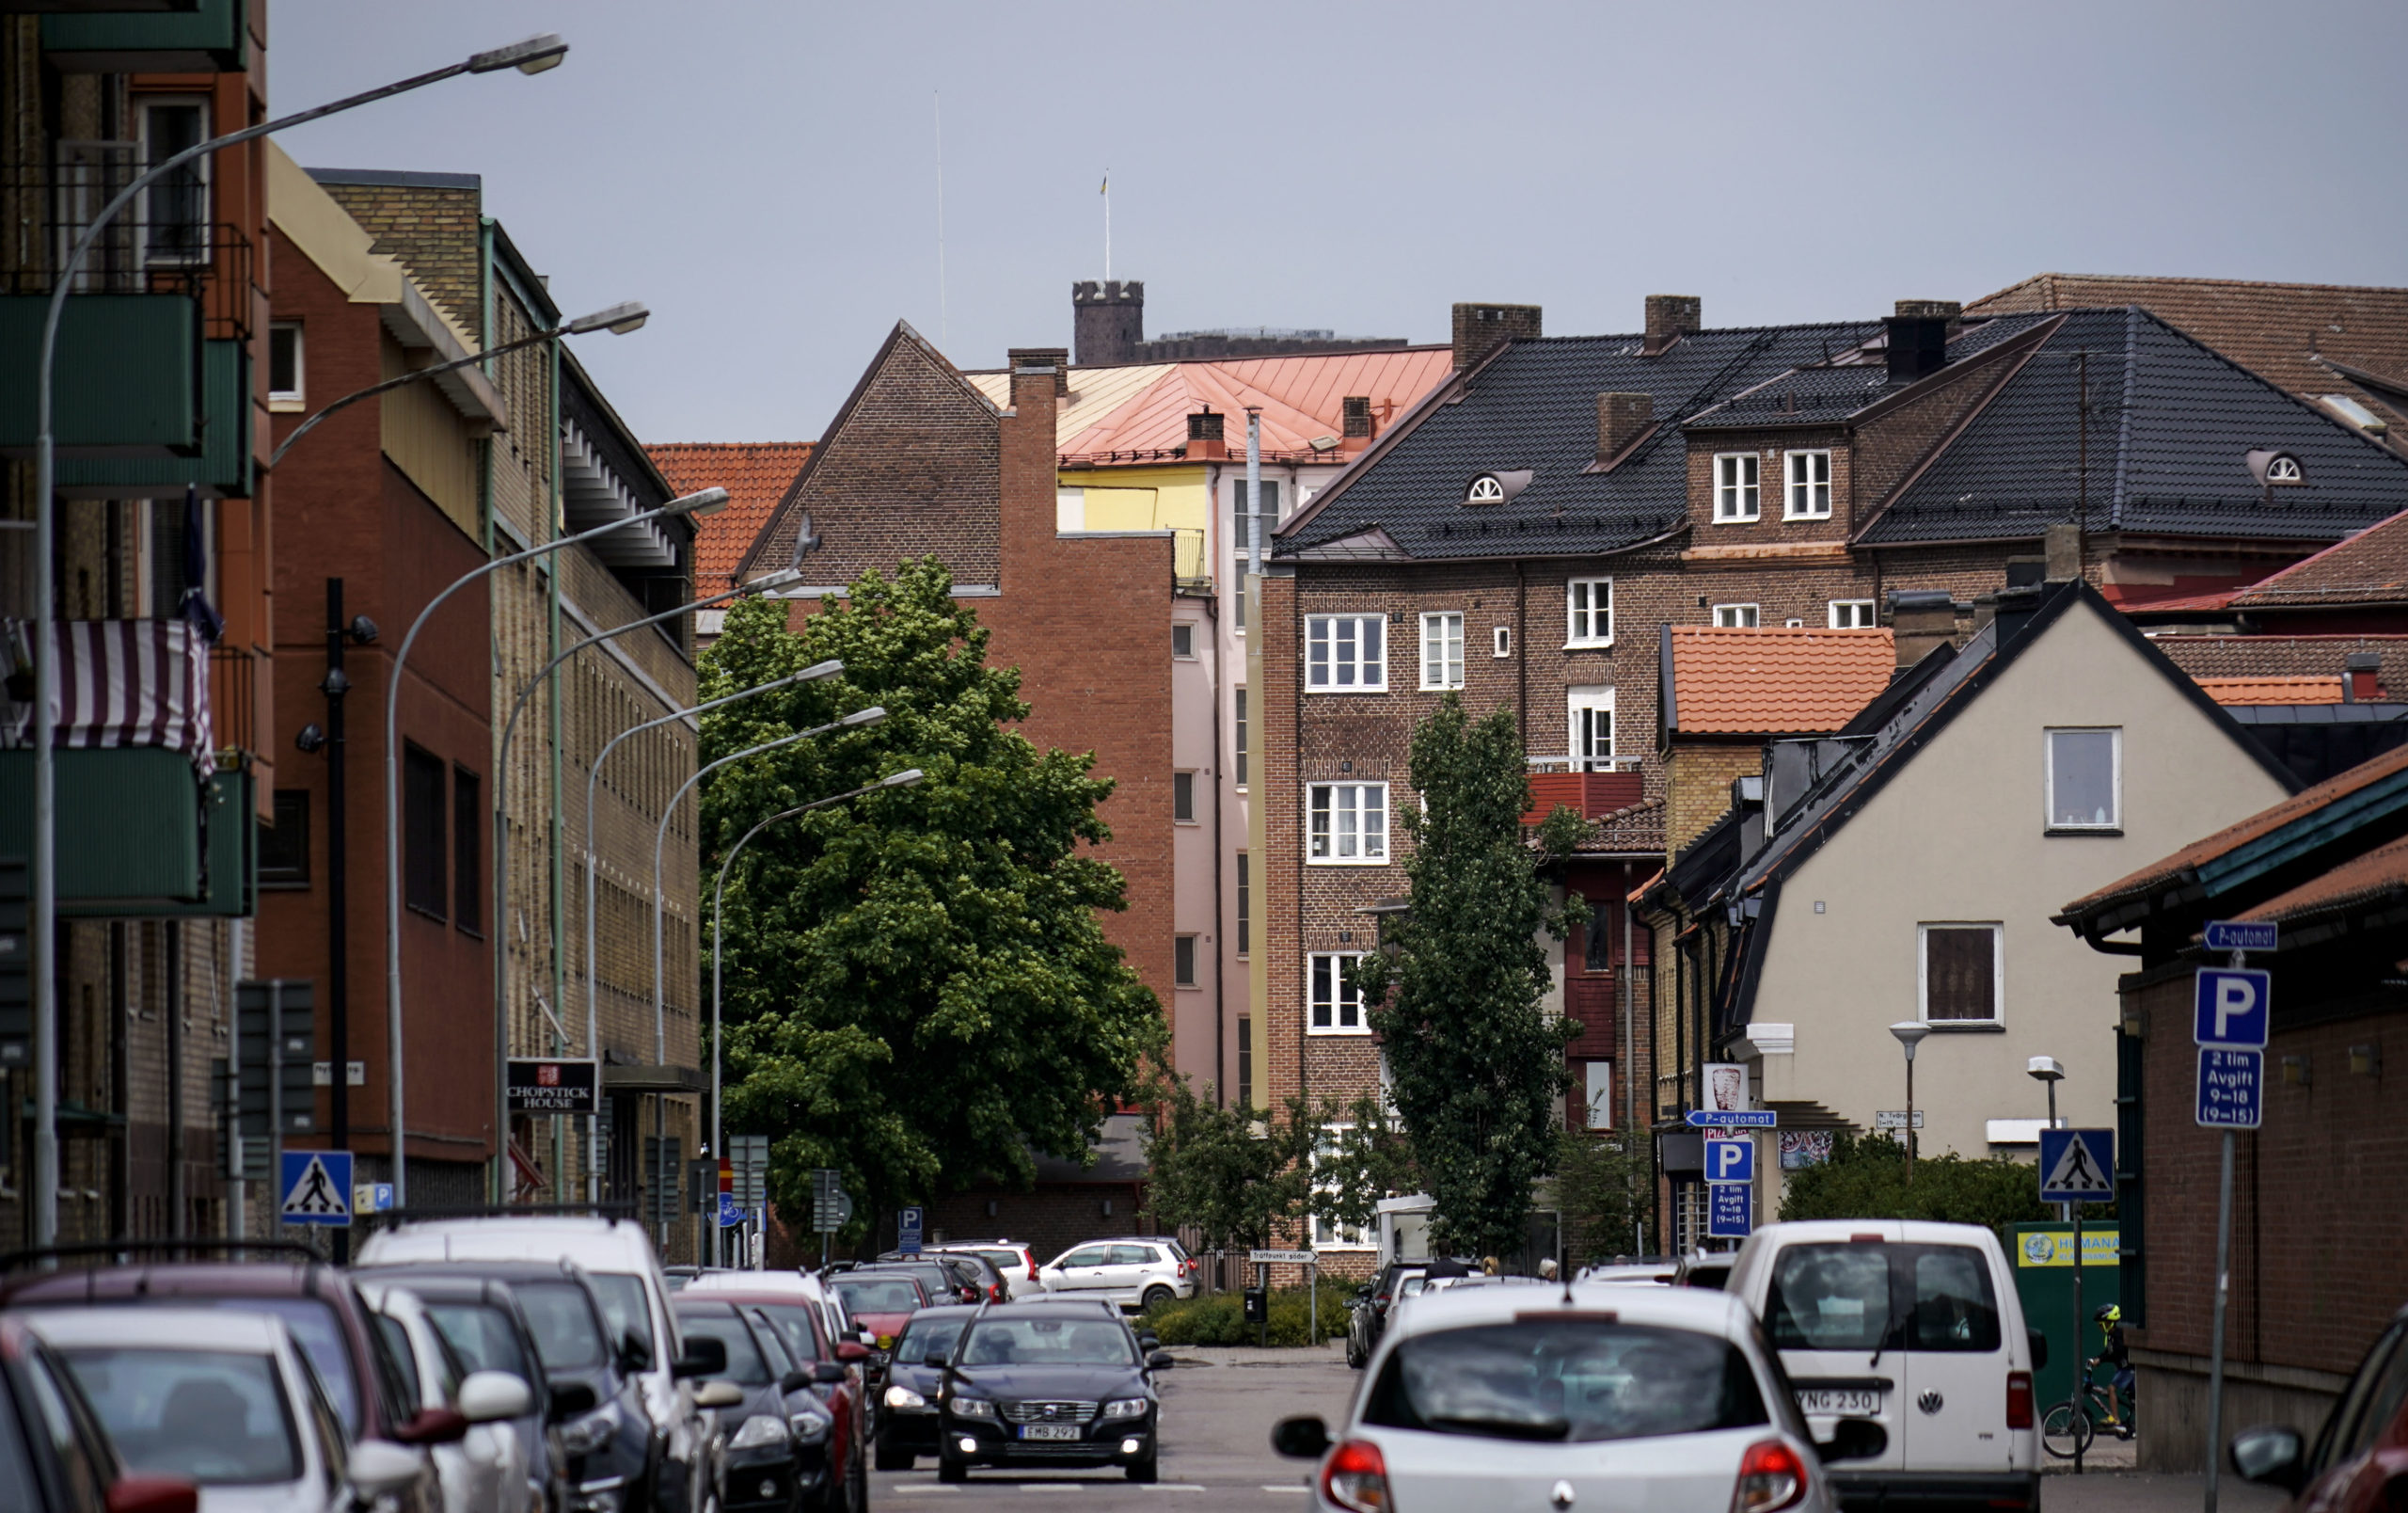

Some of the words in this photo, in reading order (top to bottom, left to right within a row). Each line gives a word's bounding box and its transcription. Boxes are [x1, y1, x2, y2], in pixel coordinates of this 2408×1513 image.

[2219, 926, 2273, 945] P-automat
[2215, 977, 2256, 1038] P
[2212, 1051, 2222, 1066] 2
[2226, 1052, 2249, 1068] tim
[2208, 1069, 2253, 1089] Avgift
[506, 1086, 589, 1098] CHOPSTICK
[523, 1097, 573, 1108] HOUSE
[1705, 1113, 1769, 1124] P-automat
[1719, 1144, 1743, 1178] P
[1718, 1195, 1744, 1205] Avgift
[903, 1210, 918, 1228] P
[1837, 1393, 1872, 1409] 230
[1054, 1427, 1076, 1439] 292
